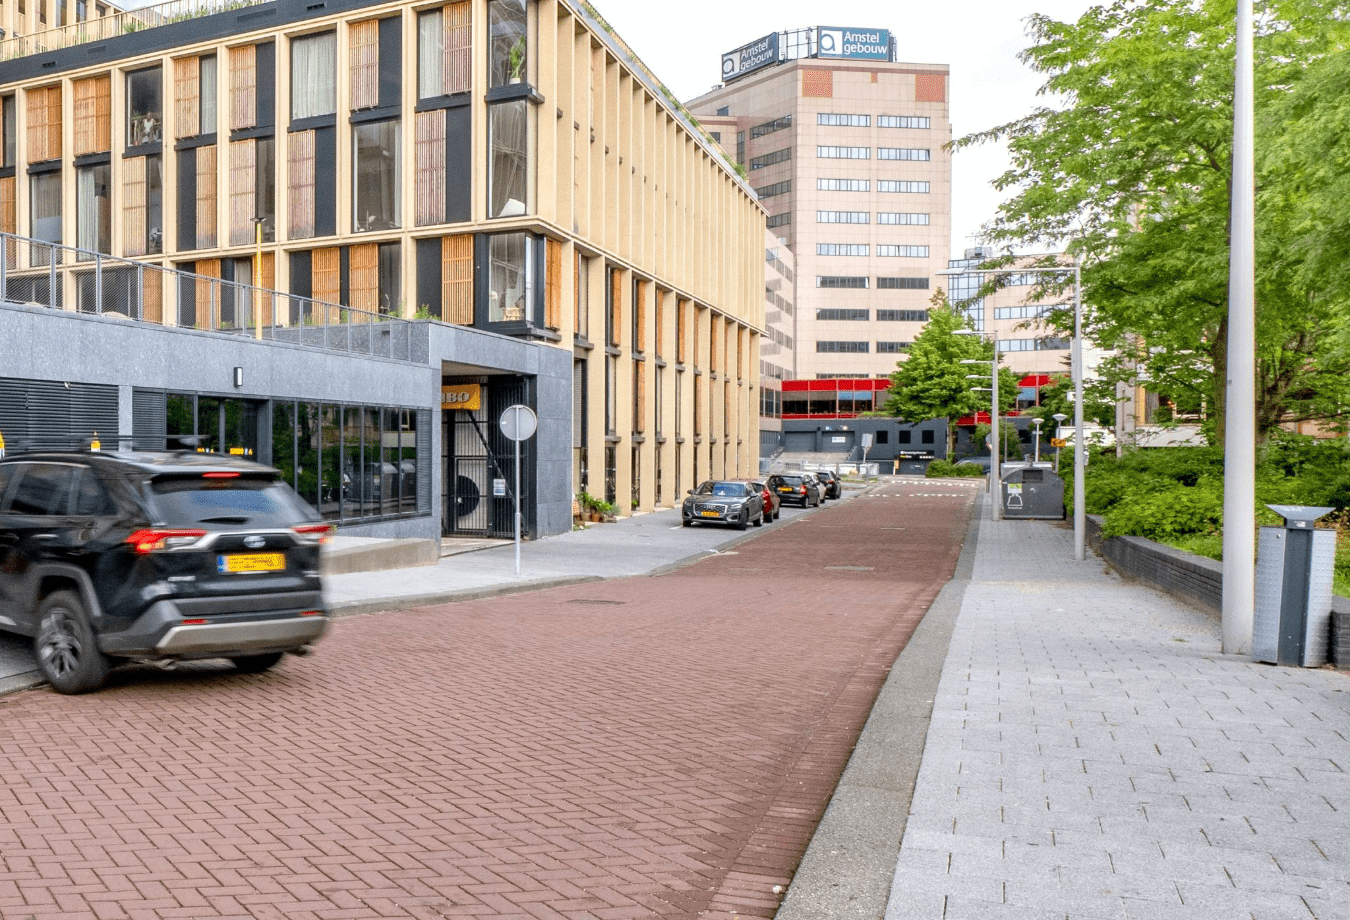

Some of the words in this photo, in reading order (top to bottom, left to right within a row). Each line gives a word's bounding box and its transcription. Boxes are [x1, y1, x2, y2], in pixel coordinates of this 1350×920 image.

[844, 31, 880, 43] Amstel
[741, 39, 769, 59] Amstel
[844, 42, 887, 55] gebouw
[740, 48, 774, 72] gebouw
